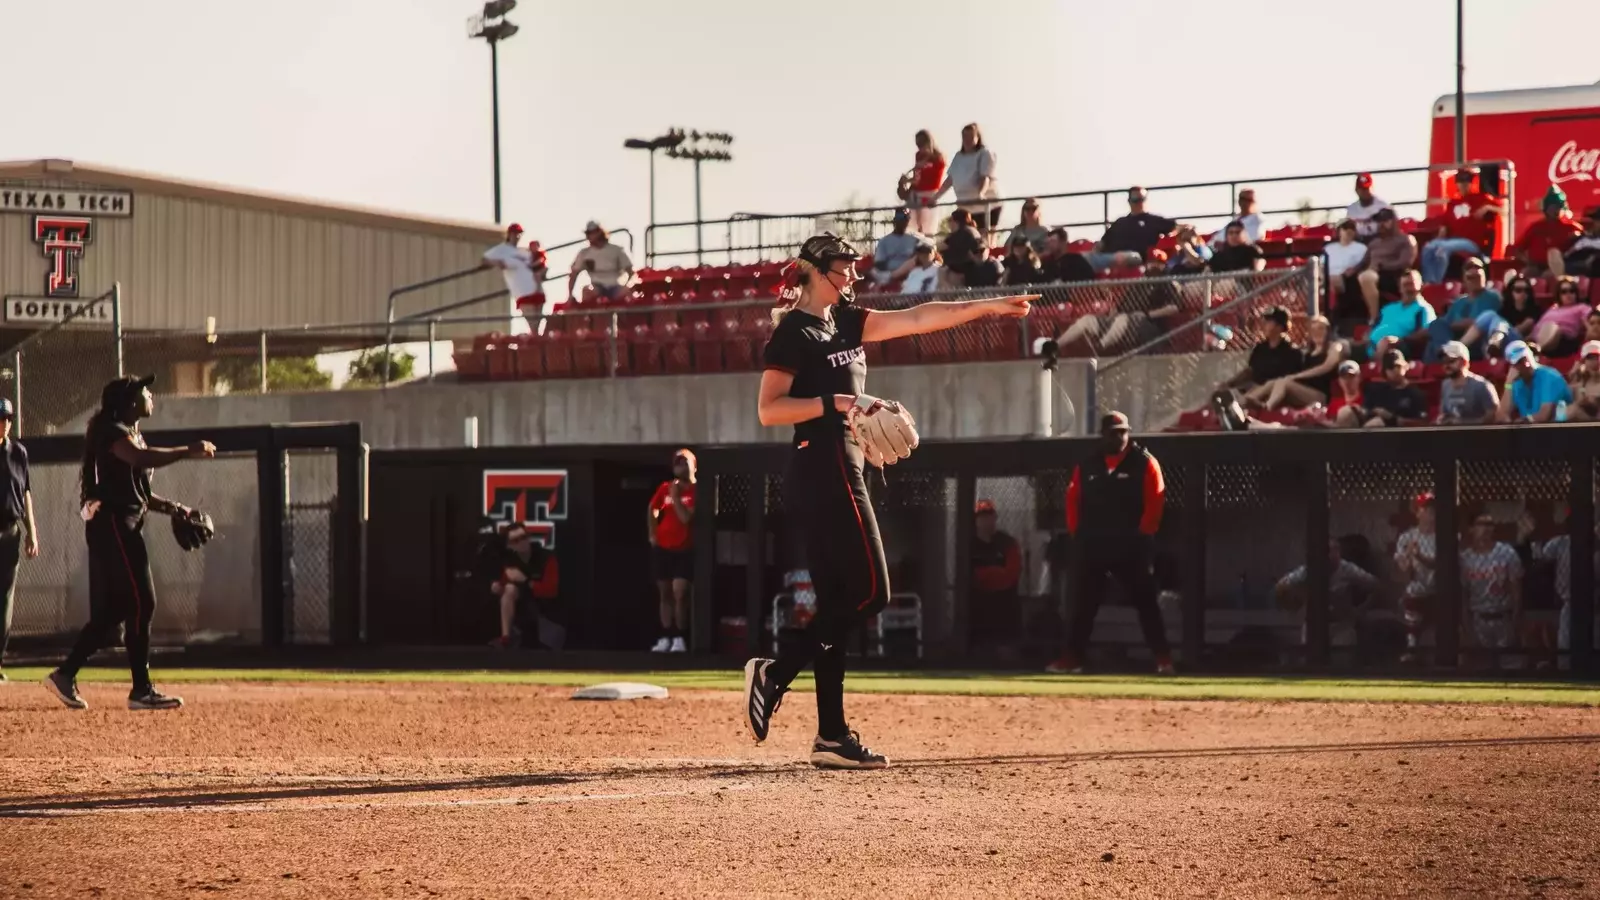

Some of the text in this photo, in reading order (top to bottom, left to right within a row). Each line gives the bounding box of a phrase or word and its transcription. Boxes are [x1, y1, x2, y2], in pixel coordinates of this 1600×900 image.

[3, 190, 124, 212] TEXAS TECH
[14, 301, 108, 319] SOFTBALL
